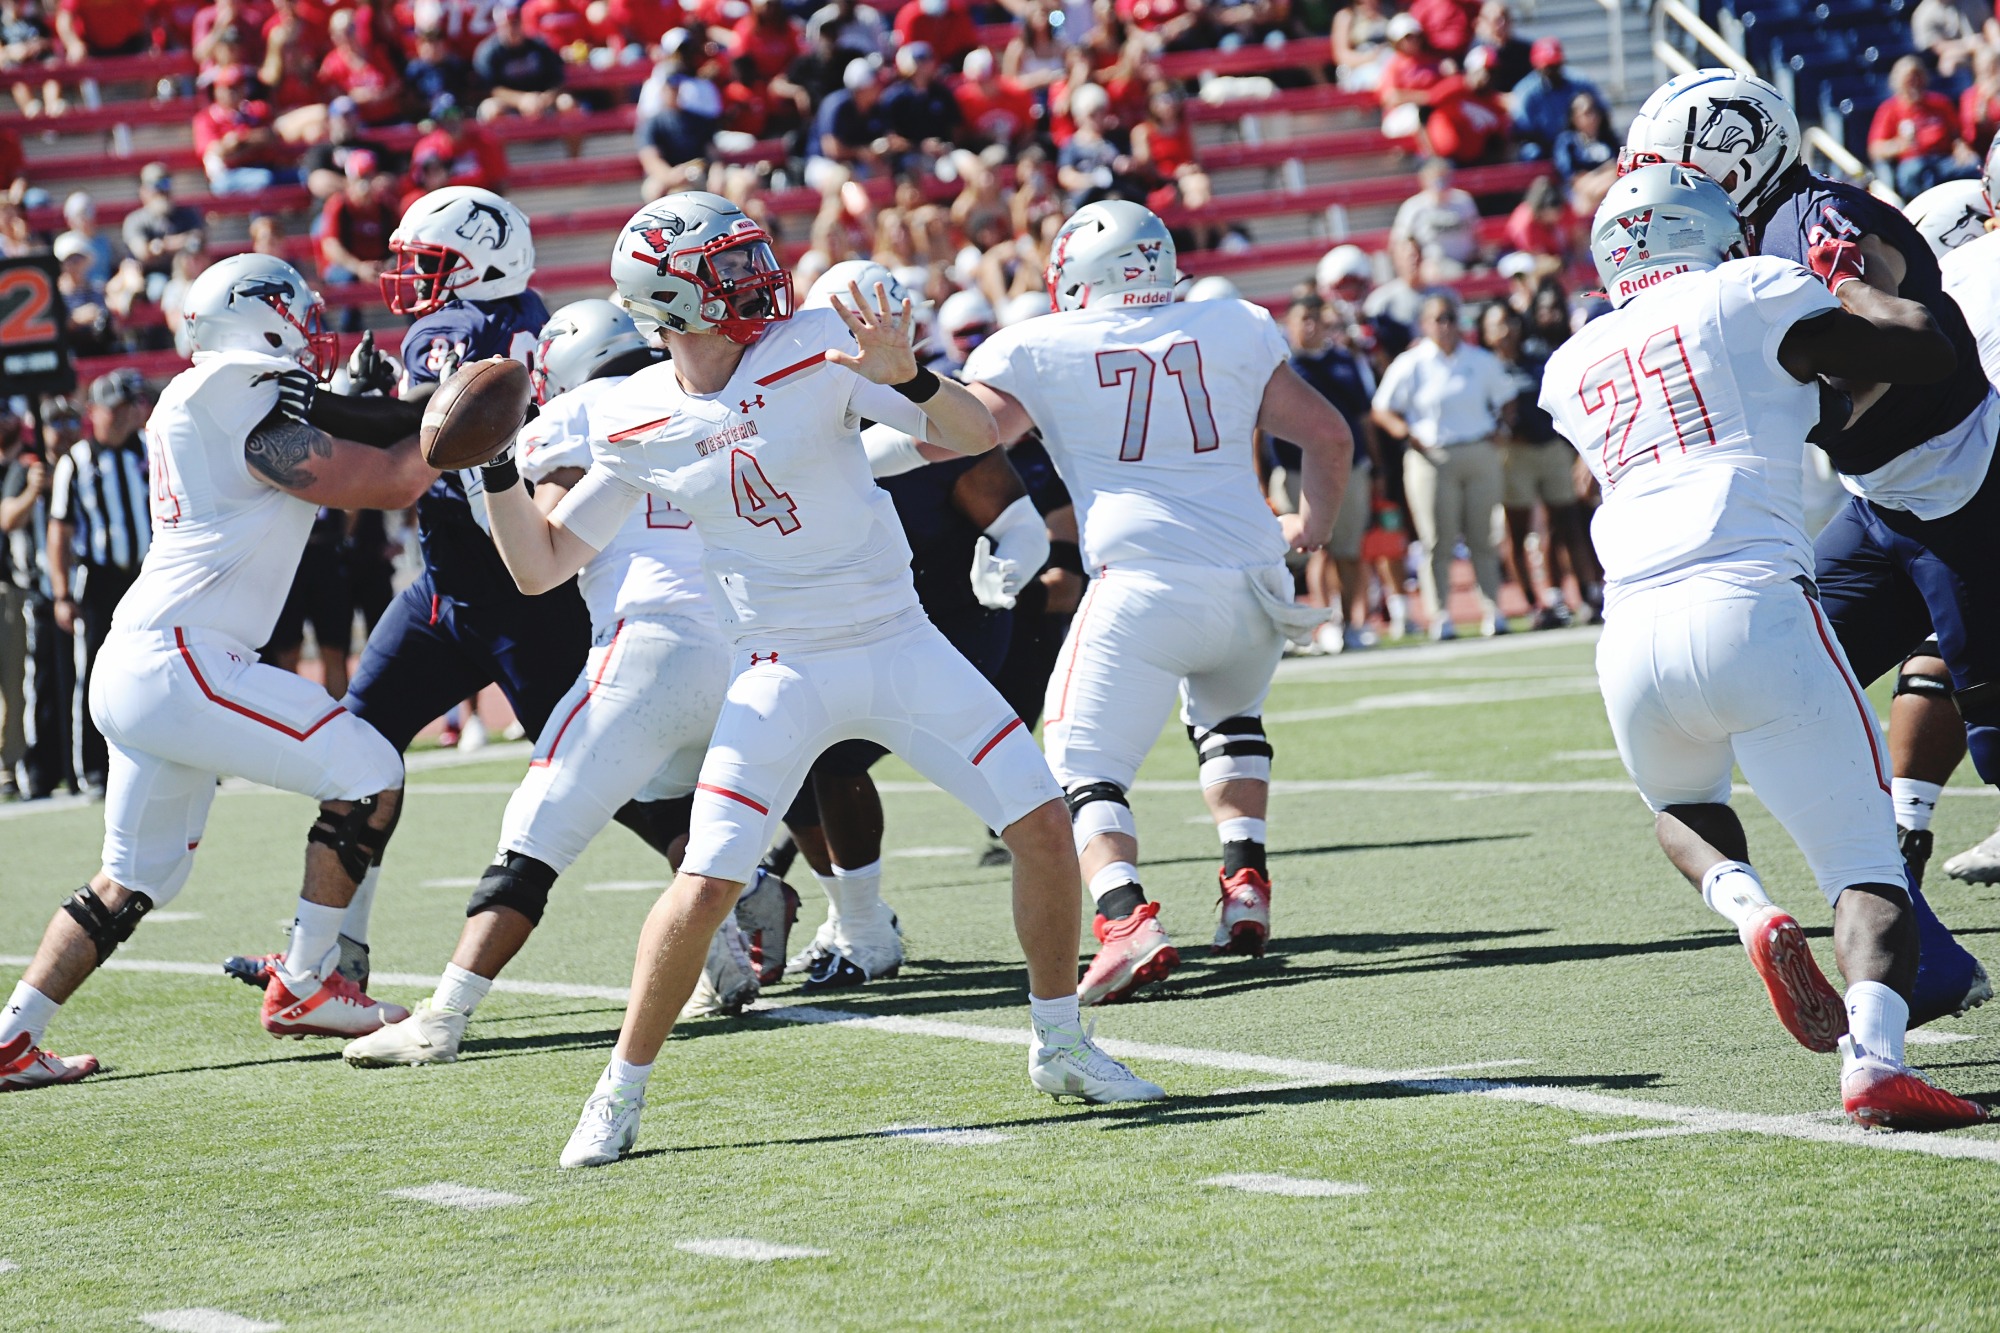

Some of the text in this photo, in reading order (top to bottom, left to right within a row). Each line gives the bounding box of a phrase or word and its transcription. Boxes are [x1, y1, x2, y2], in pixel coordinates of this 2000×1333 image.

[0, 267, 57, 345] 2
[1123, 290, 1173, 305] Riddell
[694, 419, 759, 457] WESTERN
[1095, 339, 1219, 462] 71
[1578, 324, 1717, 490] 21
[731, 447, 802, 536] 4
